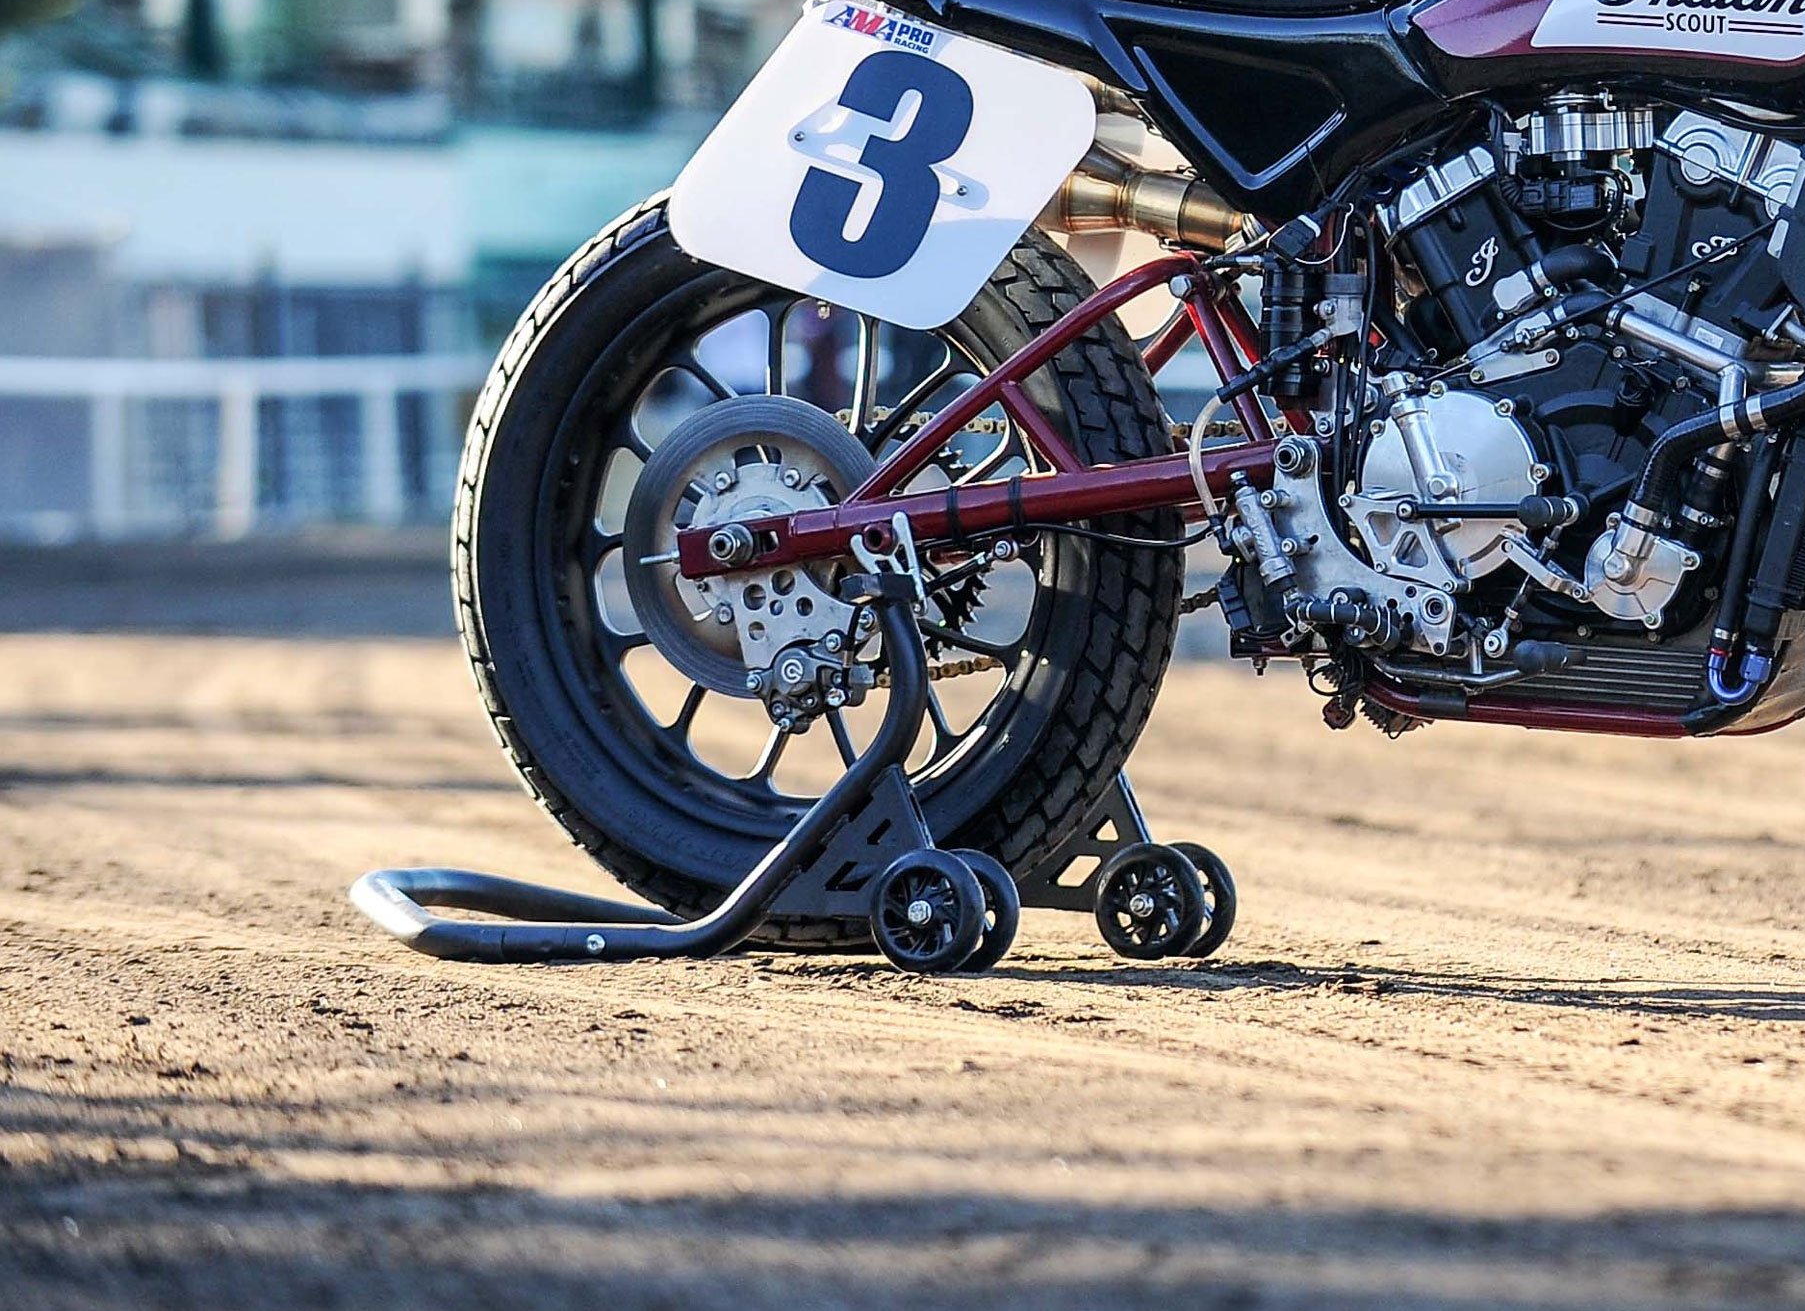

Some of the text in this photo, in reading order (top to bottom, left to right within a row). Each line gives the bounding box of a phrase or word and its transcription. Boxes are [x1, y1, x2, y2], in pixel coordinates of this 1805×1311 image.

[825, 5, 935, 46] AMA PRO
[1666, 12, 1727, 34] SCOUT
[893, 37, 930, 54] RACING
[790, 50, 974, 279] 3
